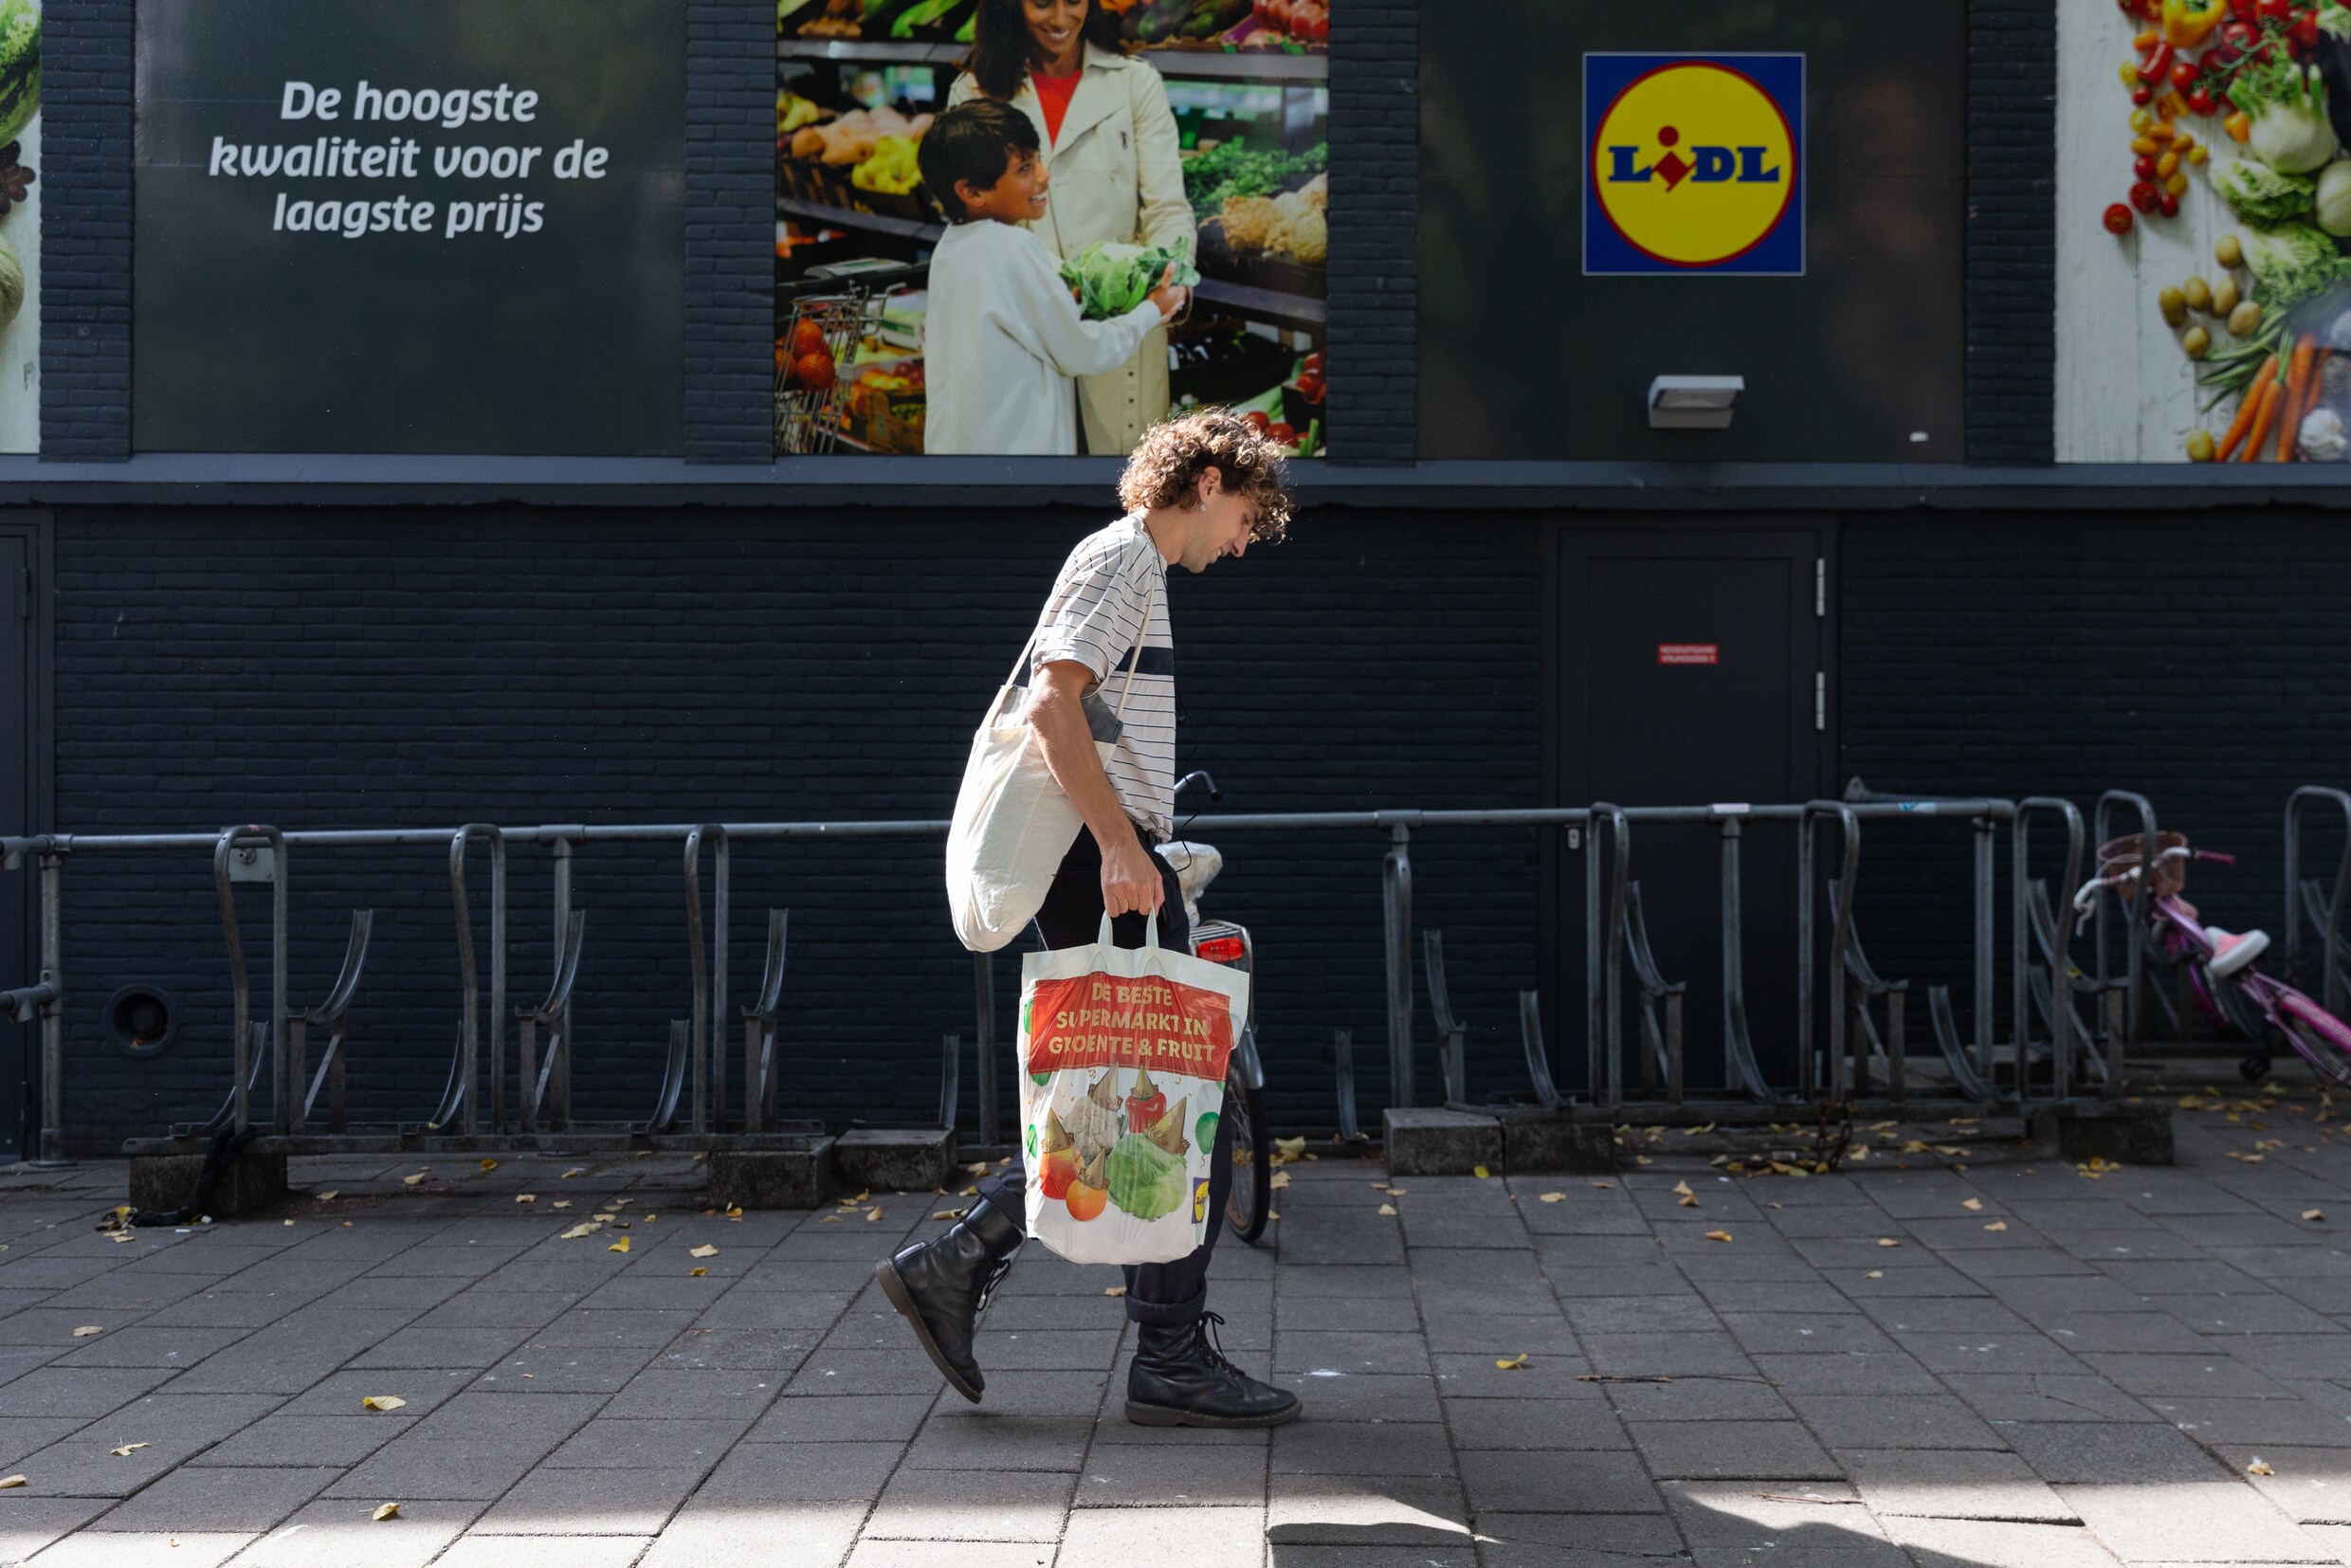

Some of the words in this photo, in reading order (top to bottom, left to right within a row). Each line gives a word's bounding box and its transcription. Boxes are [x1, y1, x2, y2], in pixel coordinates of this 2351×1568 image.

[281, 80, 342, 121] De
[354, 80, 538, 129] hoogste
[209, 136, 421, 178] kwaliteit
[433, 145, 543, 178] voor
[553, 138, 610, 179] de
[272, 192, 435, 239] laagste
[446, 192, 545, 239] prijs
[1091, 982, 1112, 1002] DE
[1117, 985, 1173, 1007] BESTE
[1055, 1008, 1179, 1033] SUPERMARKT
[1183, 1017, 1210, 1036] IN
[1138, 1037, 1154, 1057] &
[1157, 1037, 1216, 1063] FRUIT
